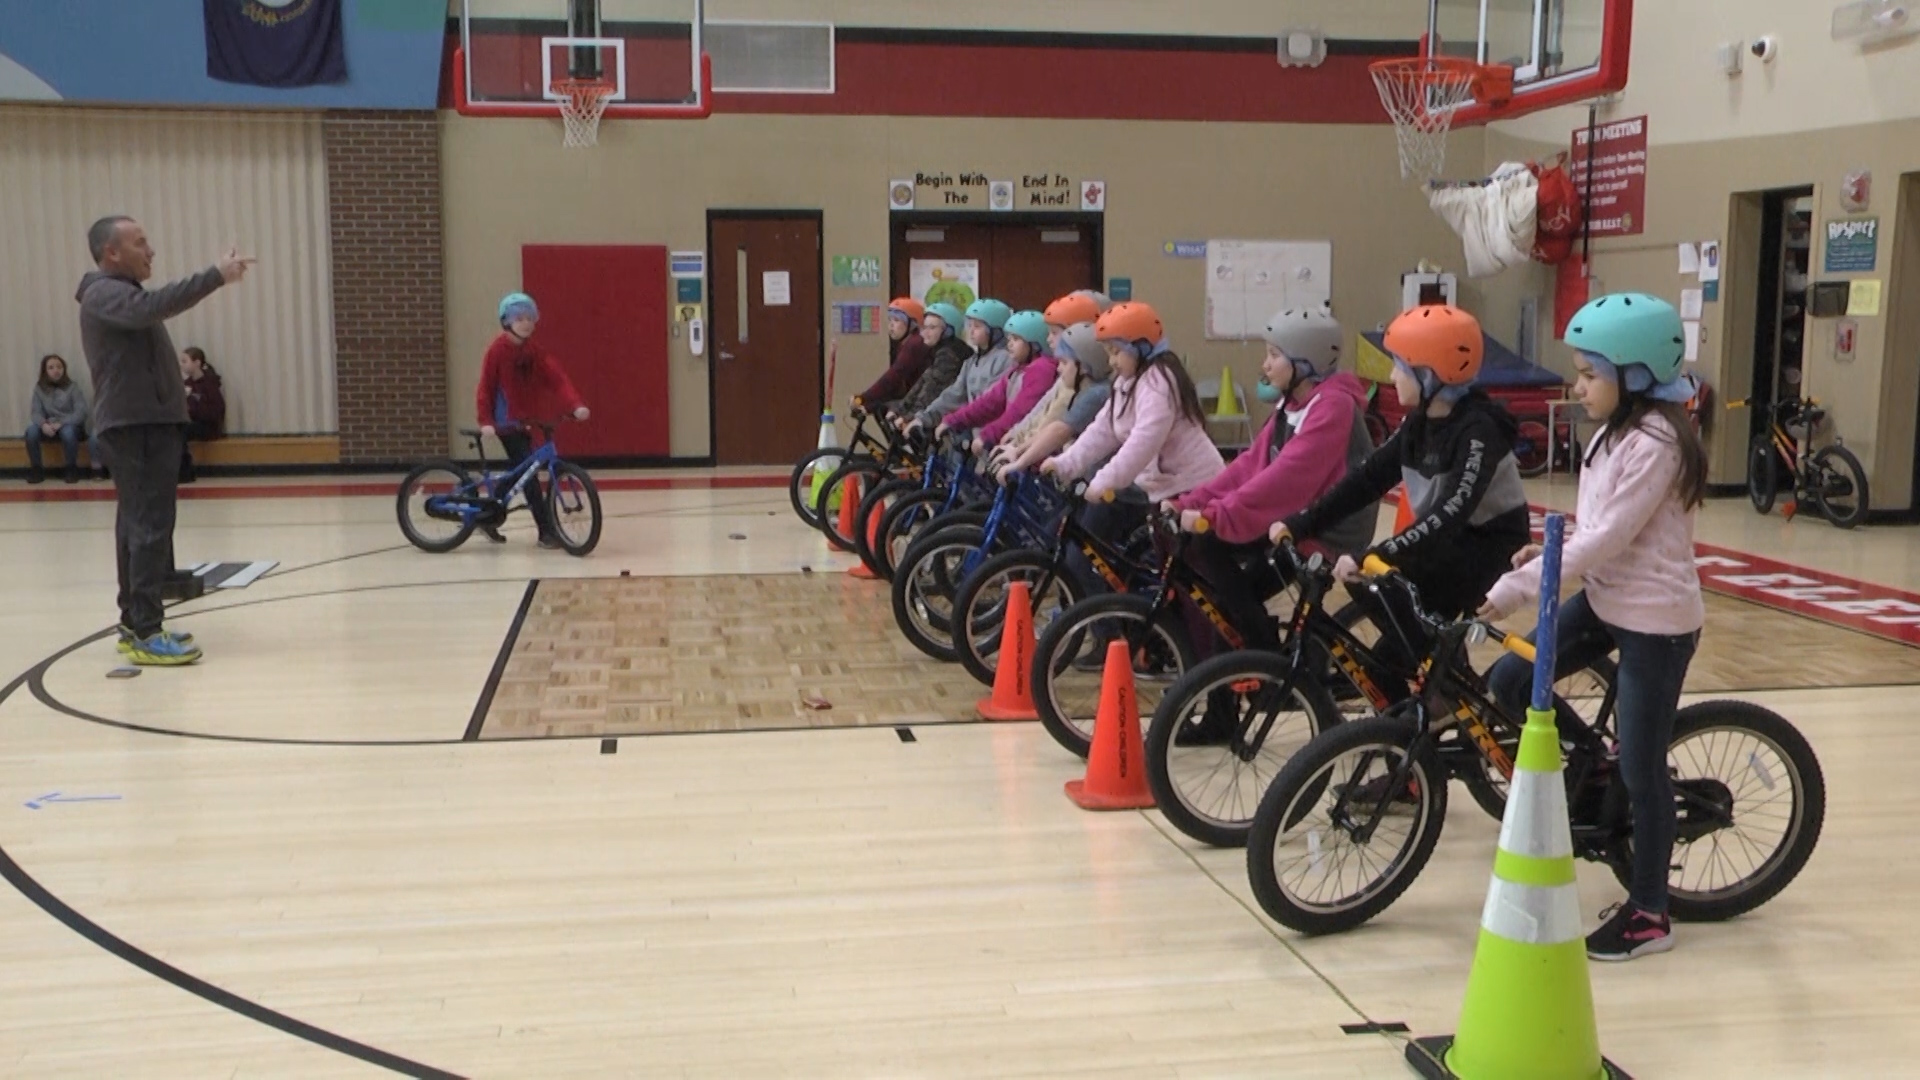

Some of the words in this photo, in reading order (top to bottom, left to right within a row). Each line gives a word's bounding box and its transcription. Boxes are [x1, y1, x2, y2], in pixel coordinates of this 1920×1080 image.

[915, 173, 953, 187] Begin
[959, 171, 988, 186] With
[1023, 174, 1047, 187] End
[1054, 174, 1069, 187] In
[943, 191, 969, 204] The
[1029, 190, 1071, 206] Mind!
[1384, 512, 1442, 554] EAGLE
